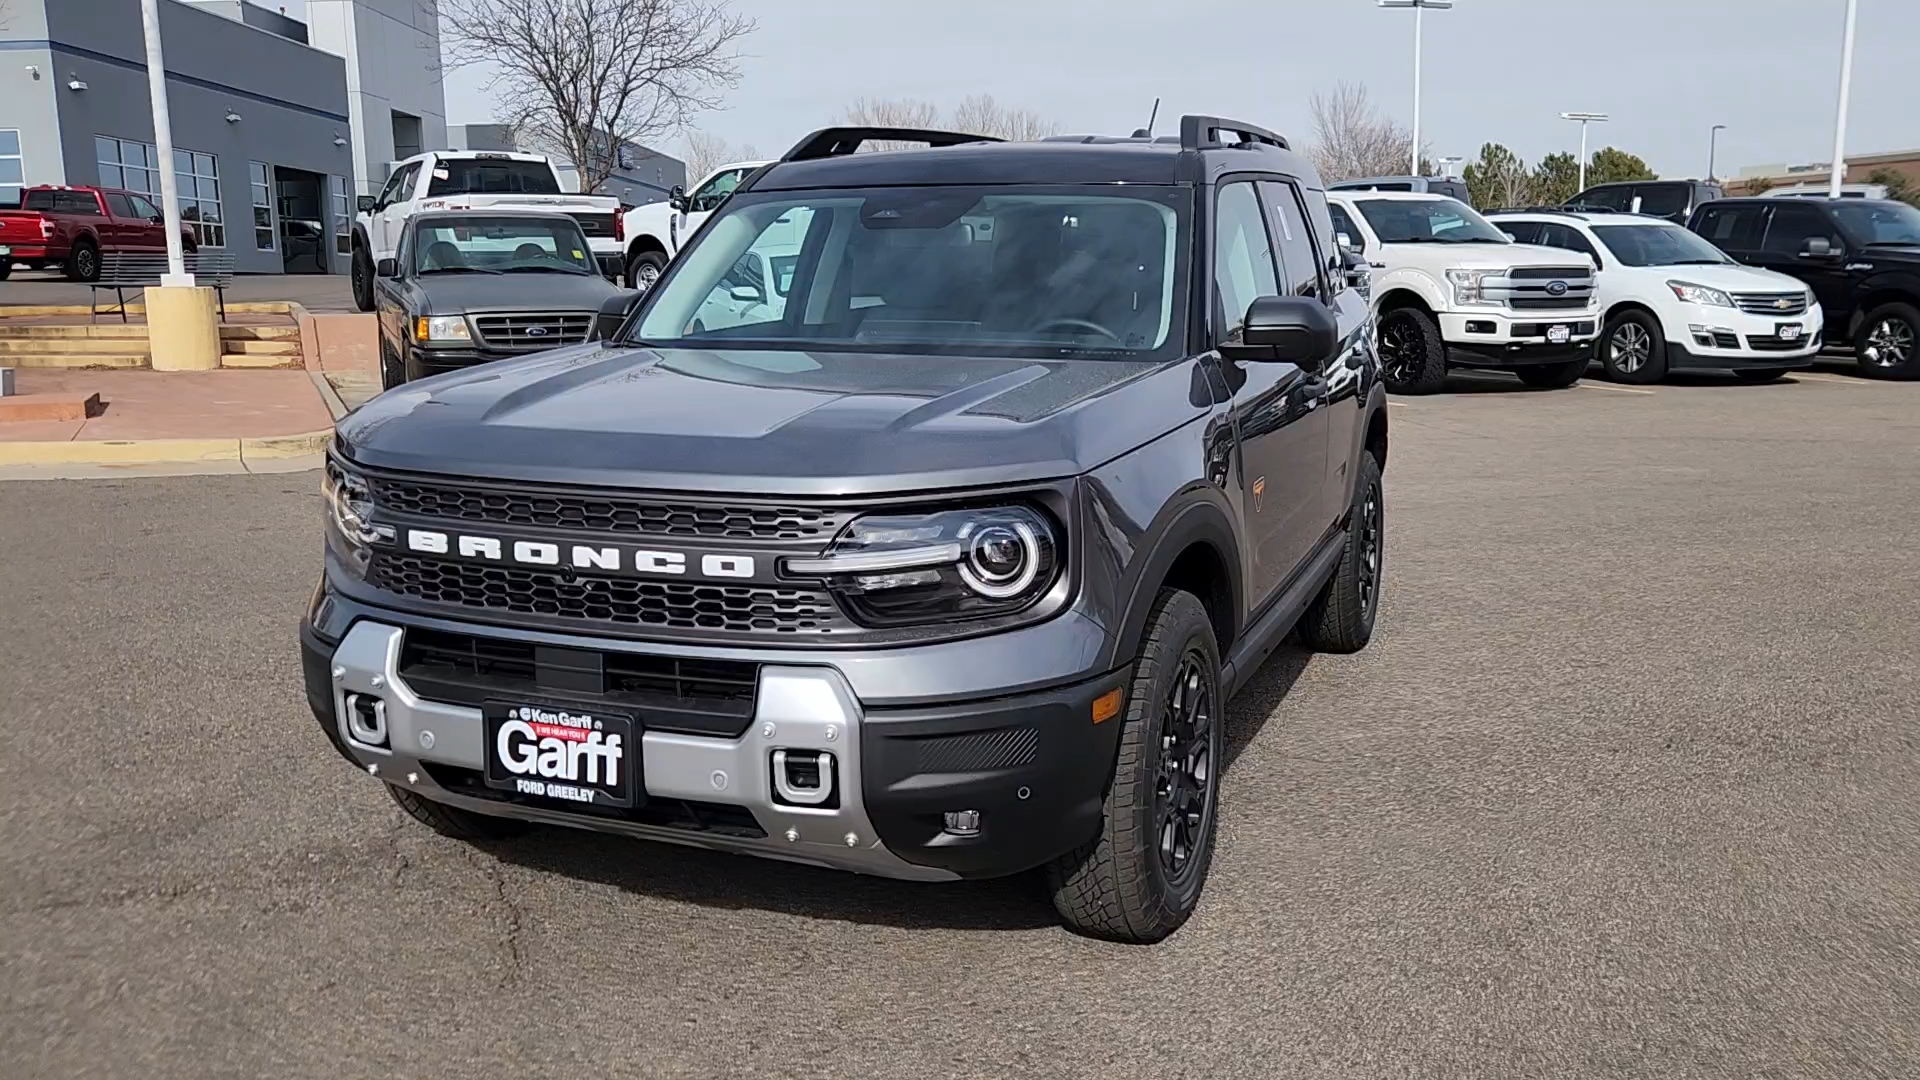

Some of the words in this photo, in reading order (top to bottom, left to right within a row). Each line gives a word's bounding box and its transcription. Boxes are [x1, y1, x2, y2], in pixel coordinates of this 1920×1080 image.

[408, 529, 755, 577] BRONCO
[531, 708, 558, 725] Ken
[558, 711, 592, 730] Garff
[541, 726, 551, 734] WE
[551, 727, 568, 737] HEAR
[568, 731, 580, 739] YOU
[497, 720, 623, 786] Garff
[516, 779, 545, 796] FORD
[547, 784, 595, 803] GREELEY
